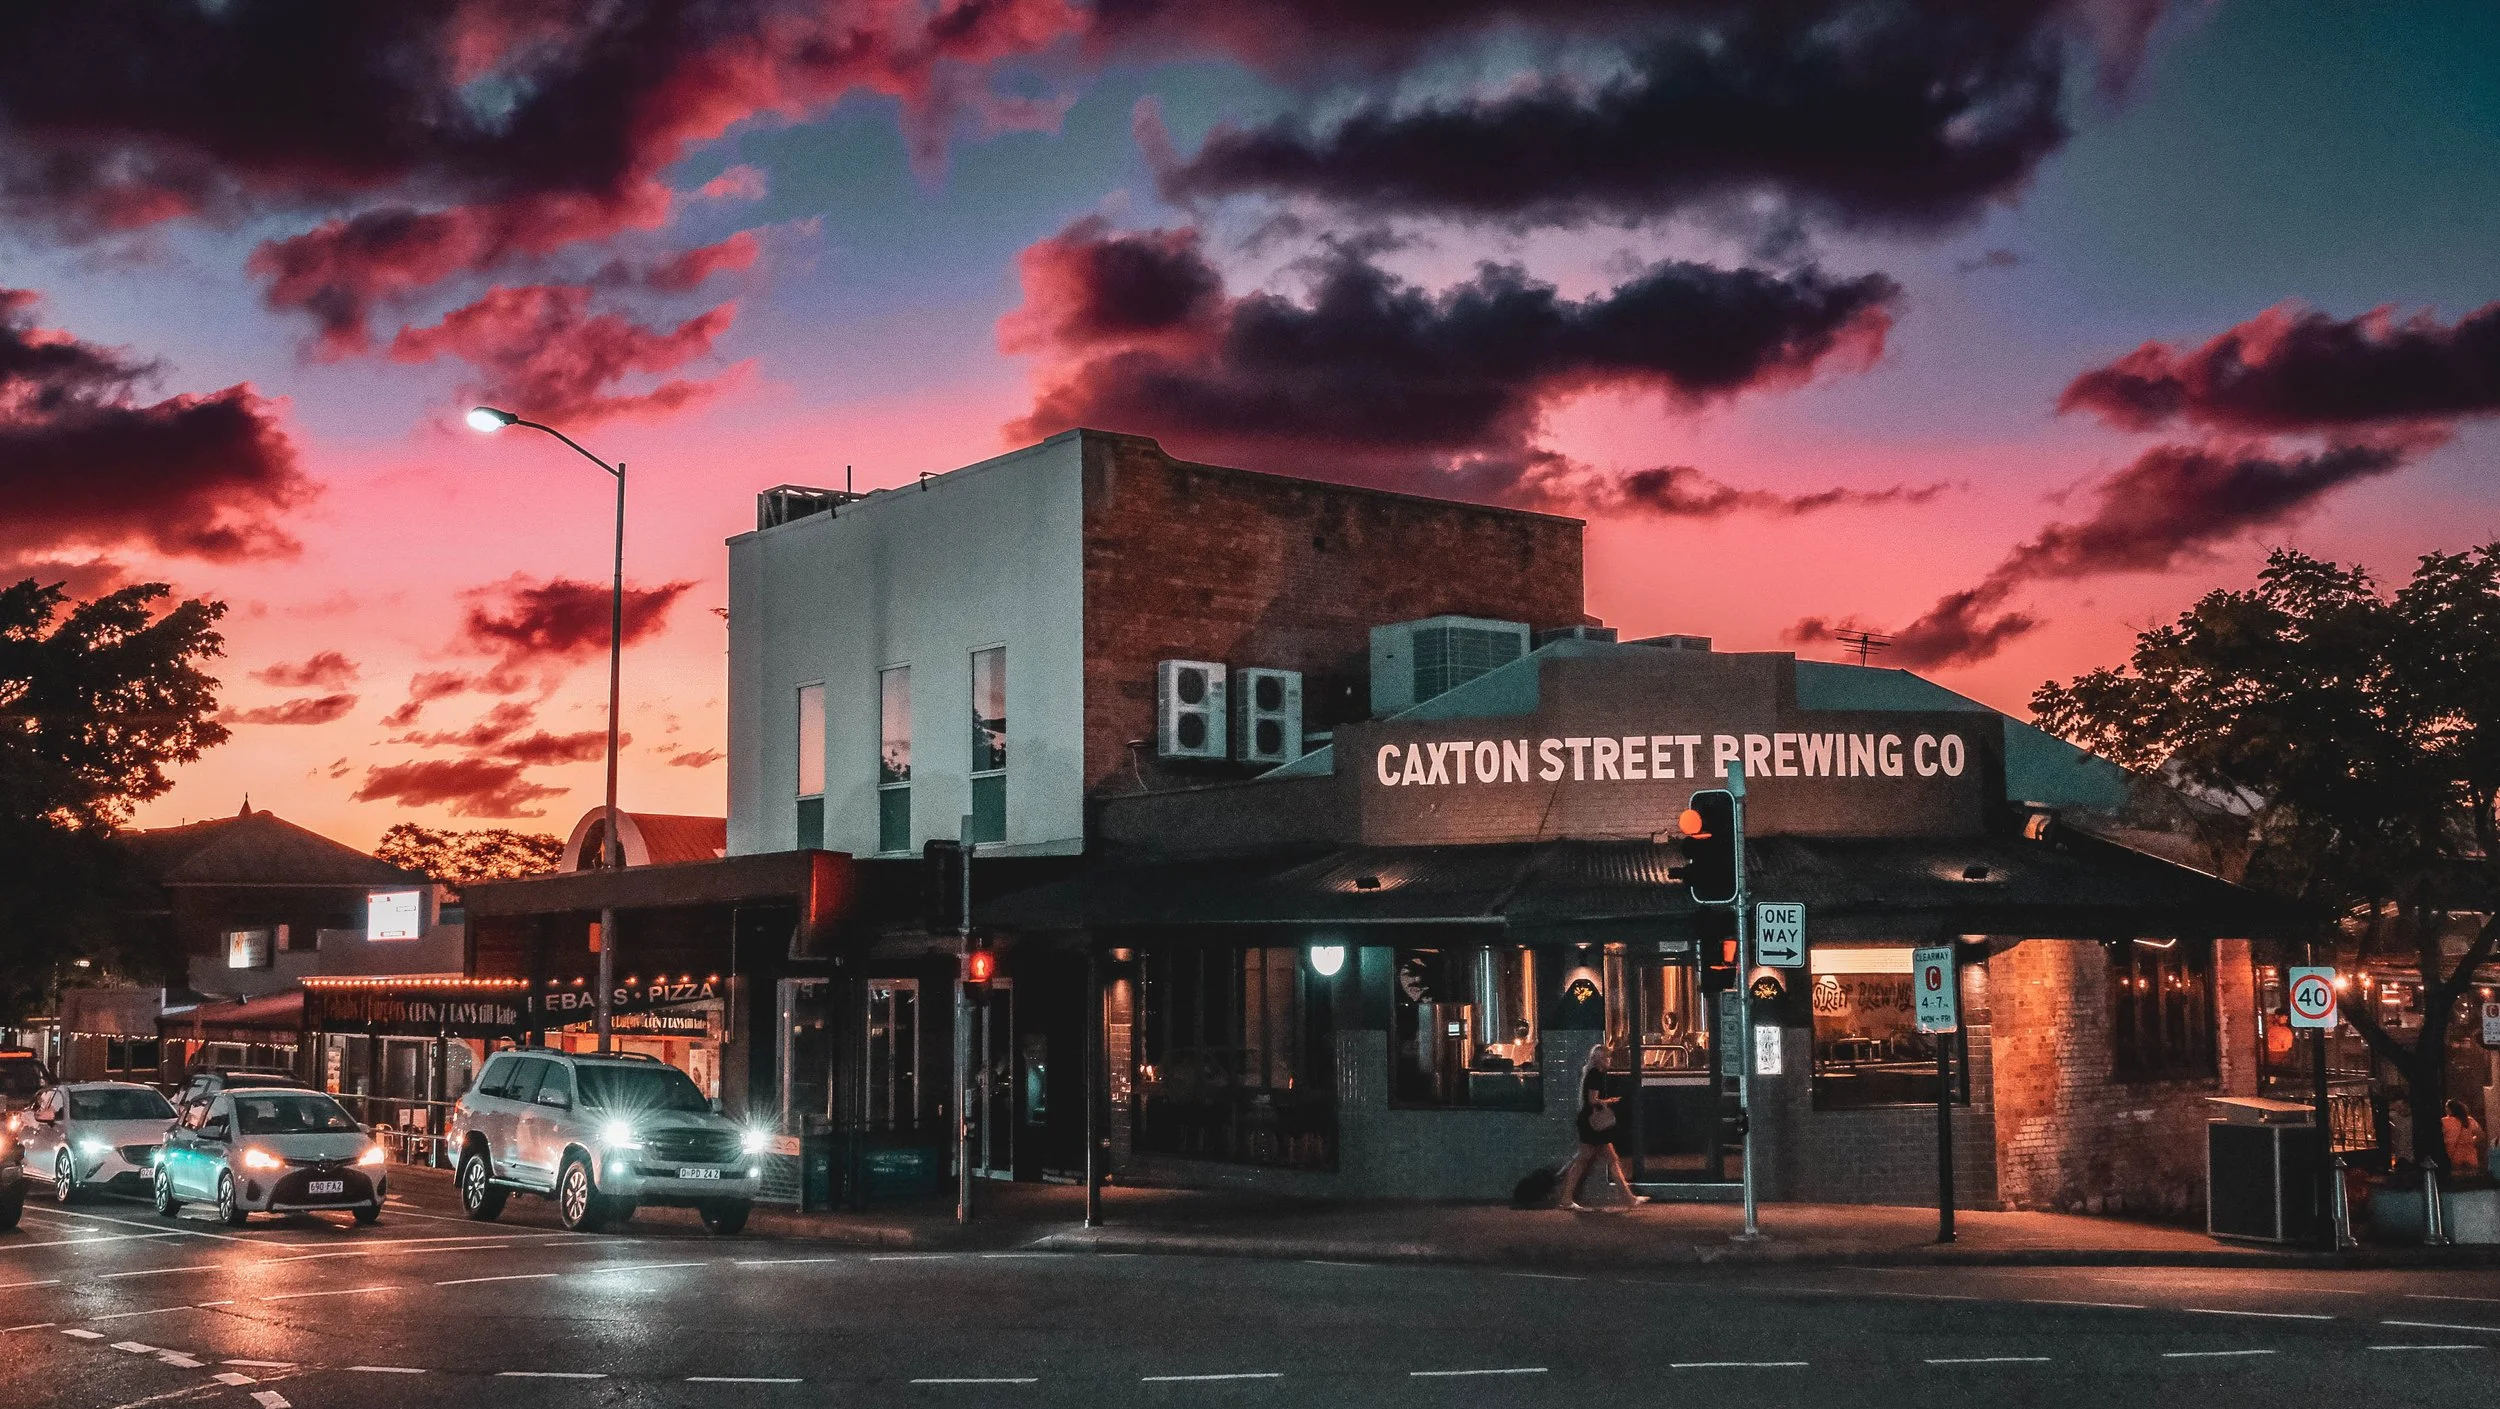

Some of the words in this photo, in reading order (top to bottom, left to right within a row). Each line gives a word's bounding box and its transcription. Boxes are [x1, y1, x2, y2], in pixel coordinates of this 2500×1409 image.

[1377, 739, 1529, 786] CAXTON
[1538, 735, 1702, 782] STREET
[1713, 733, 1904, 778] BREWING
[1913, 733, 1965, 777] CO
[1765, 909, 1797, 924] ONE
[1762, 928, 1799, 943] WAY
[1915, 951, 1949, 962] CLEARWAY
[1929, 968, 1938, 989] C
[527, 988, 629, 1013] EBAS
[648, 983, 715, 1003] PIZZA
[1813, 980, 1853, 1013] STREET
[2297, 987, 2328, 1008] 40
[310, 1182, 325, 1191] 690
[326, 1181, 342, 1191] FA2
